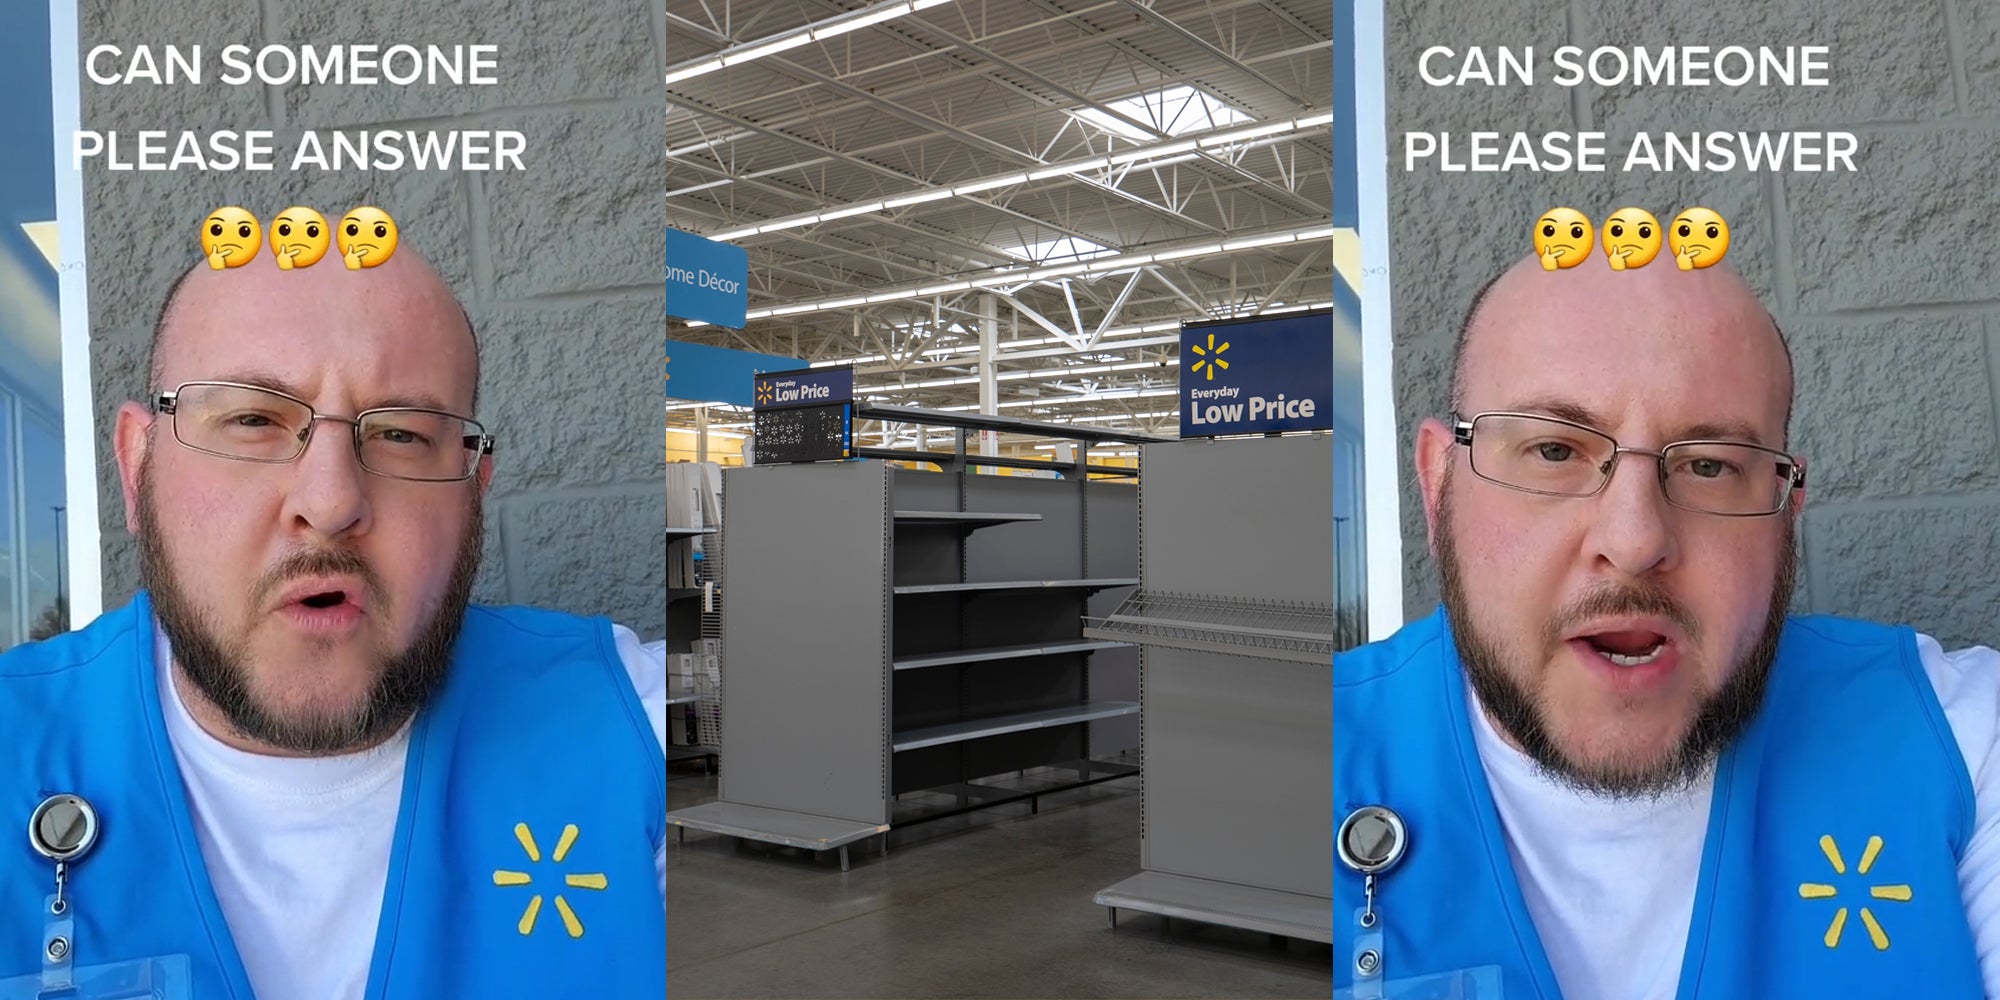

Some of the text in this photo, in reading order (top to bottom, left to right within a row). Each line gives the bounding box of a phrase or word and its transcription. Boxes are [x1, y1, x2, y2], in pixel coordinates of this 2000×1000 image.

[698, 269, 740, 295] Décor
[775, 380, 796, 388] Everyday
[775, 383, 830, 402] Low Price
[1191, 386, 1240, 400] Everyday
[1191, 393, 1316, 425] Low Price
